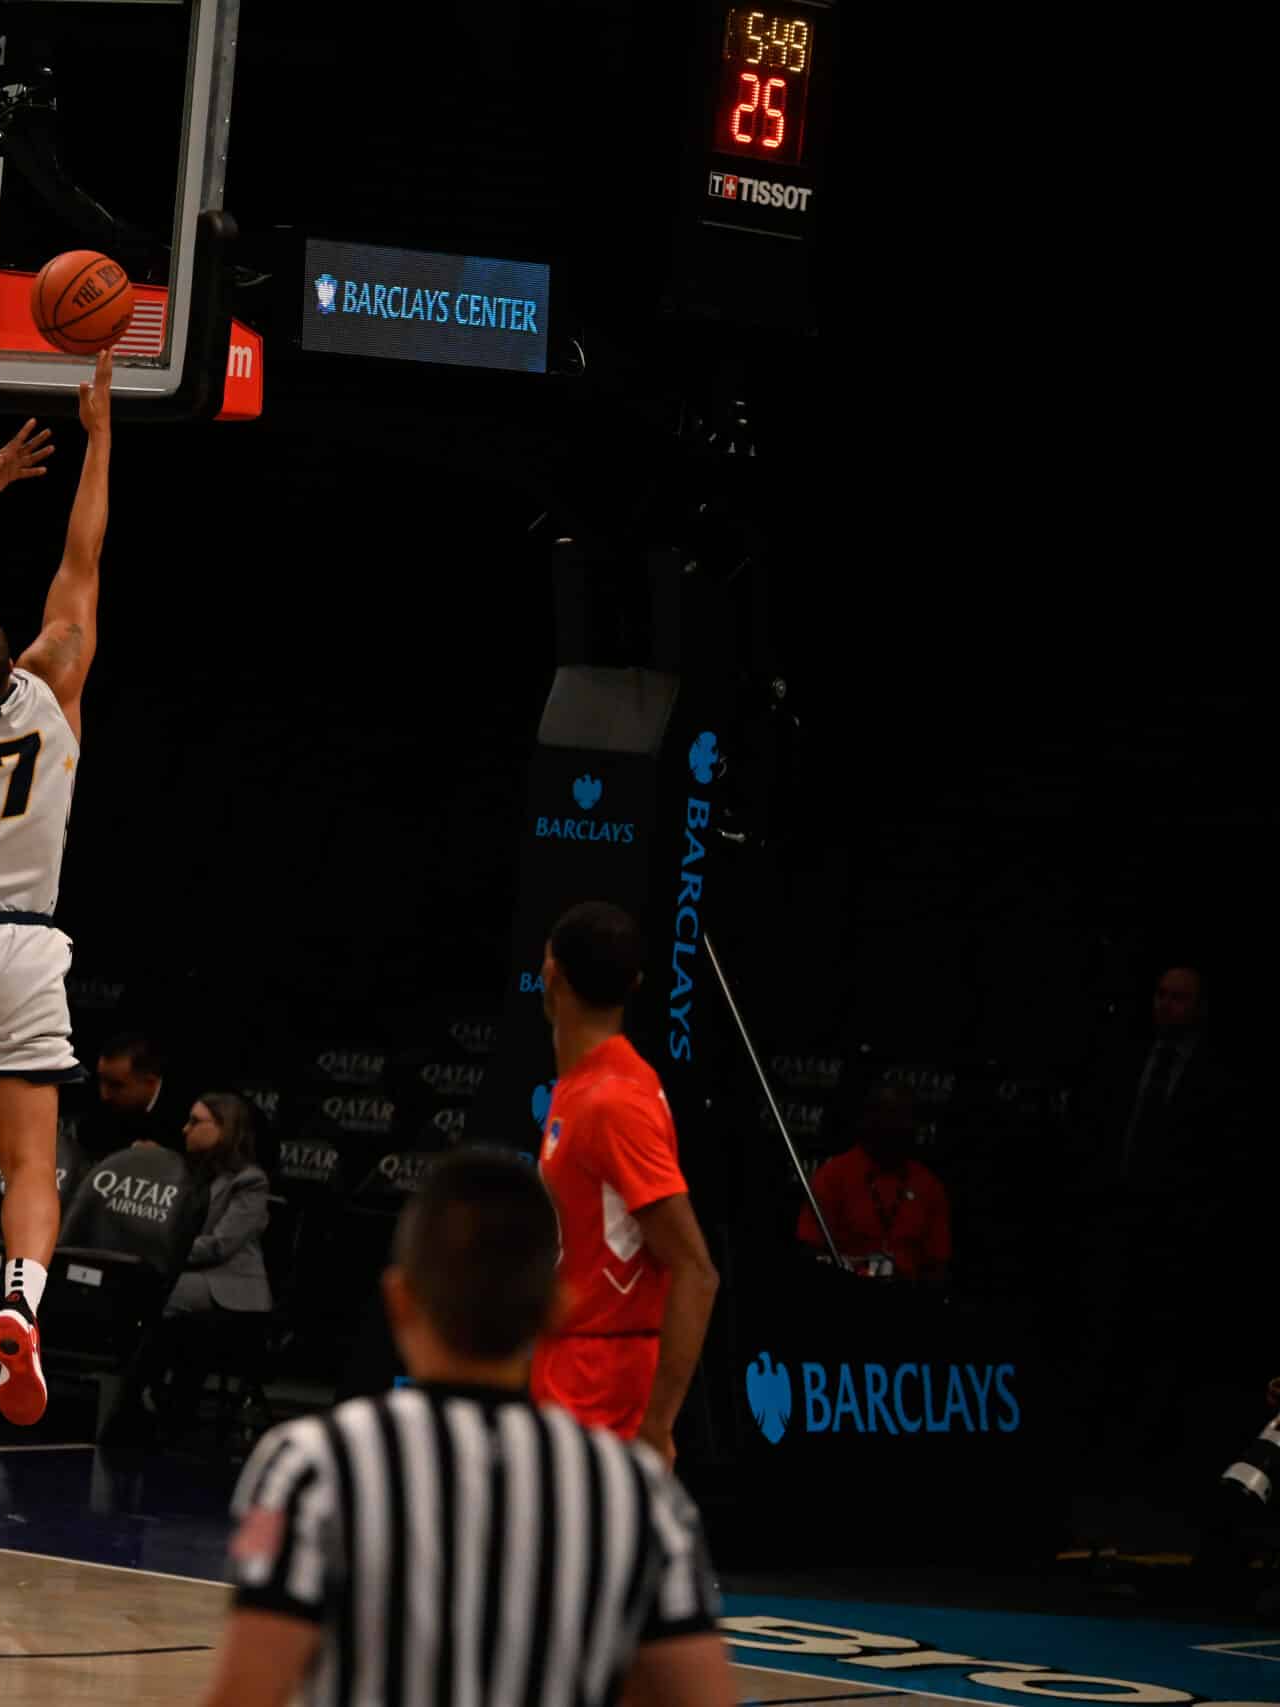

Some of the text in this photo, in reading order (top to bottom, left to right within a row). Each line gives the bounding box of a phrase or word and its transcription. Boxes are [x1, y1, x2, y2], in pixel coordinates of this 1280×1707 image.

[745, 10, 810, 73] 5:49
[730, 72, 787, 148] 25
[738, 175, 814, 212] TISSOT
[342, 278, 539, 335] BARCLAYS CENTER
[534, 815, 636, 845] BARCLAYS
[668, 796, 712, 1066] BARCLAYS
[322, 1097, 396, 1122] QATAR
[92, 1169, 180, 1208] QATAR
[104, 1197, 170, 1224] AIRWAYS
[800, 1360, 1021, 1437] BARCLAYS
